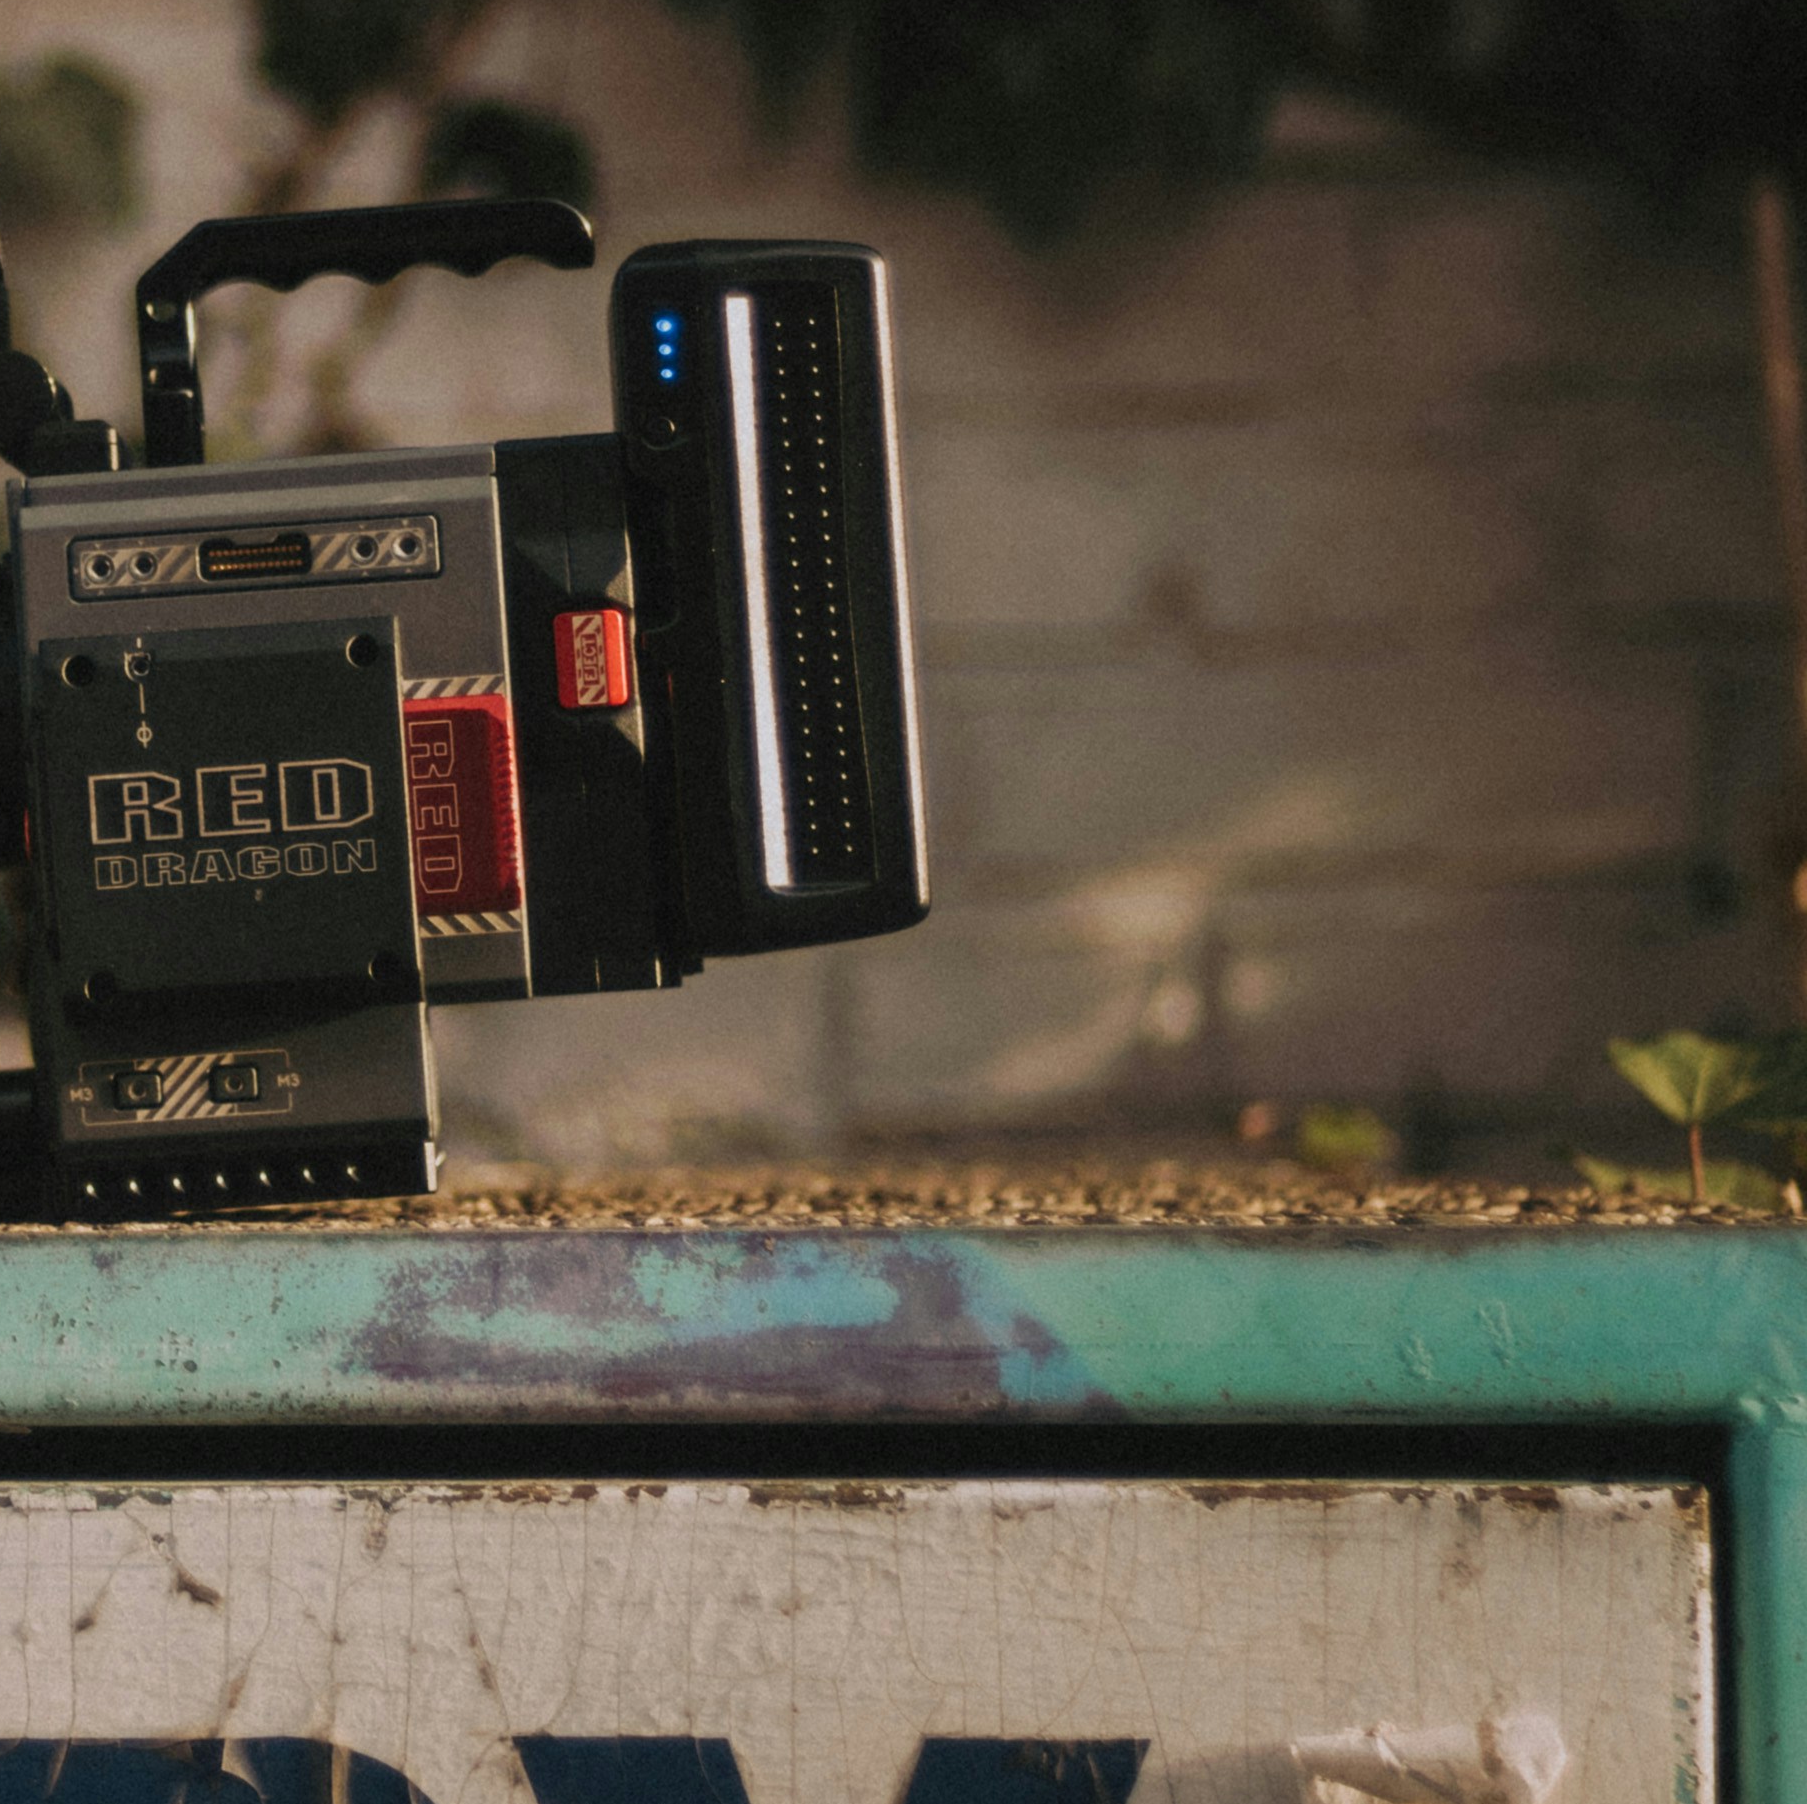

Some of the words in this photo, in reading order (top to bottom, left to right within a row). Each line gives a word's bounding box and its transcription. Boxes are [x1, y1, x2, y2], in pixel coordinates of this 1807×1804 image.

[582, 636, 598, 683] EJECT
[89, 757, 374, 845] RED
[408, 719, 463, 894] RED
[94, 839, 377, 890] DRAGON
[69, 1087, 94, 1103] M3
[276, 1073, 301, 1088] M3
